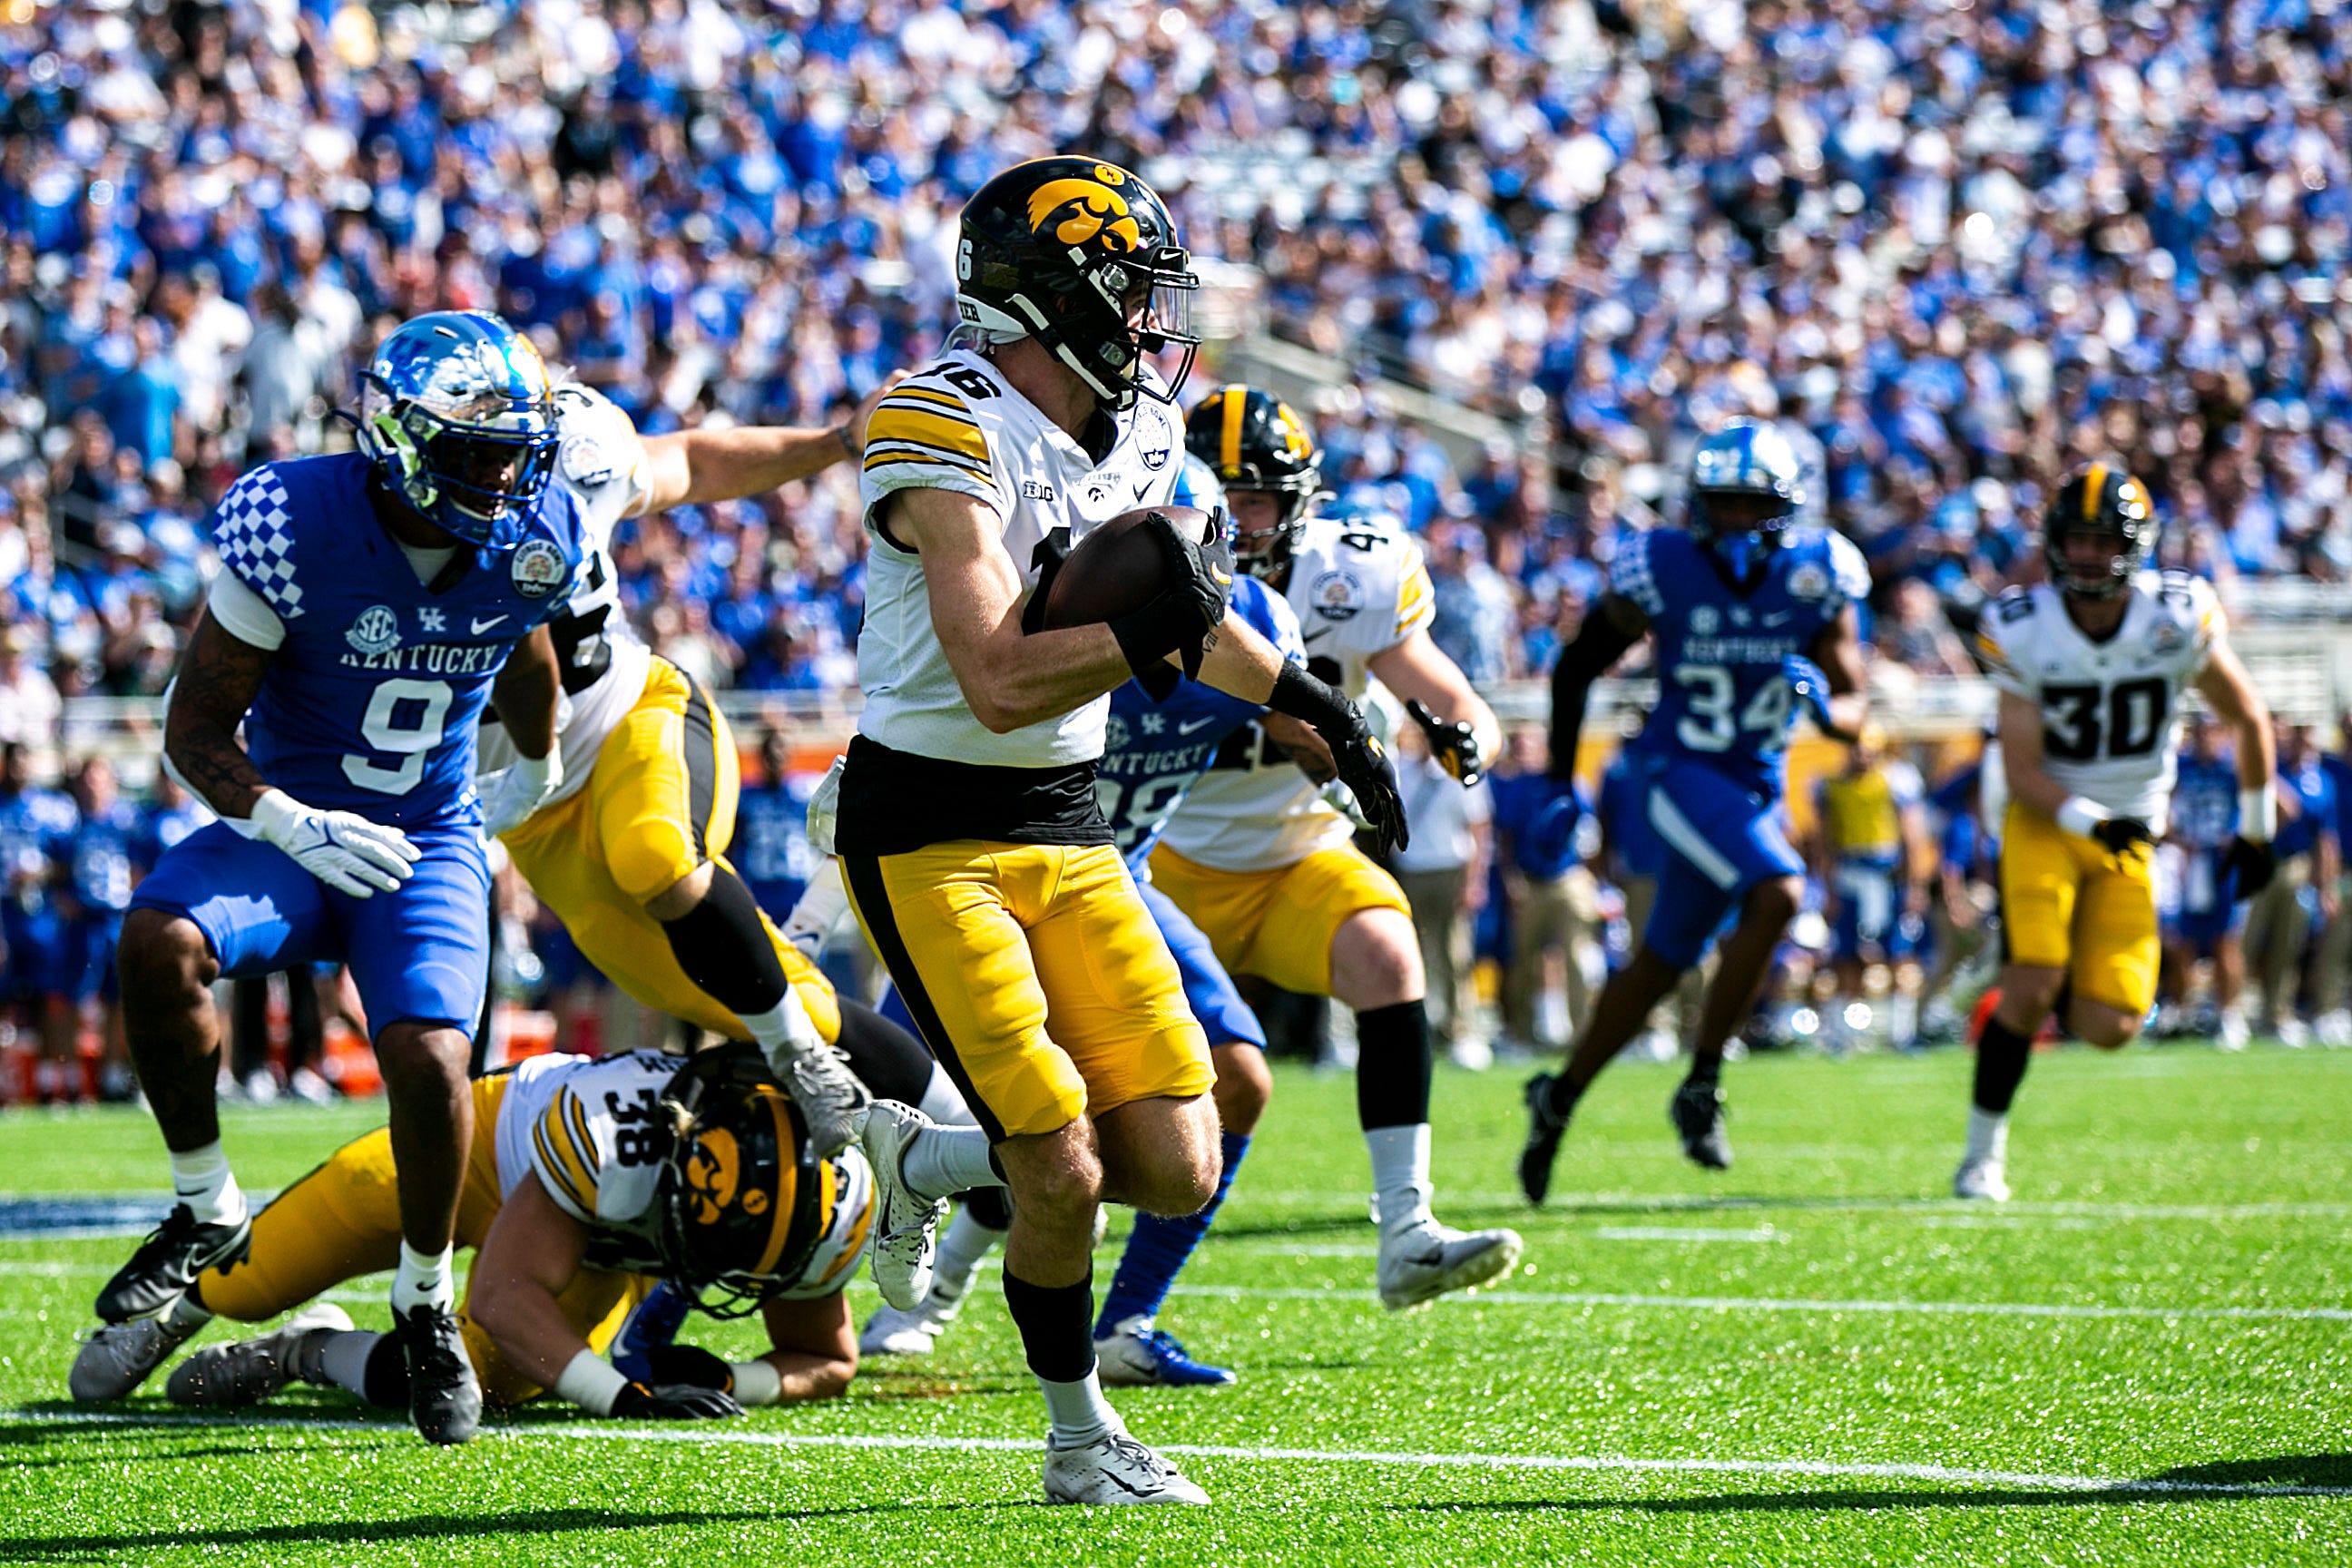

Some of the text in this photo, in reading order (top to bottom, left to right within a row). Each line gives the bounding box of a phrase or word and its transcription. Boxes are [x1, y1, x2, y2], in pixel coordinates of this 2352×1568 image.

[358, 609, 392, 642] SEC
[416, 606, 447, 632] UK
[340, 677, 454, 797] 9
[1672, 663, 1791, 754] 34
[2042, 678, 2166, 764] 30
[604, 1089, 668, 1167] 38
